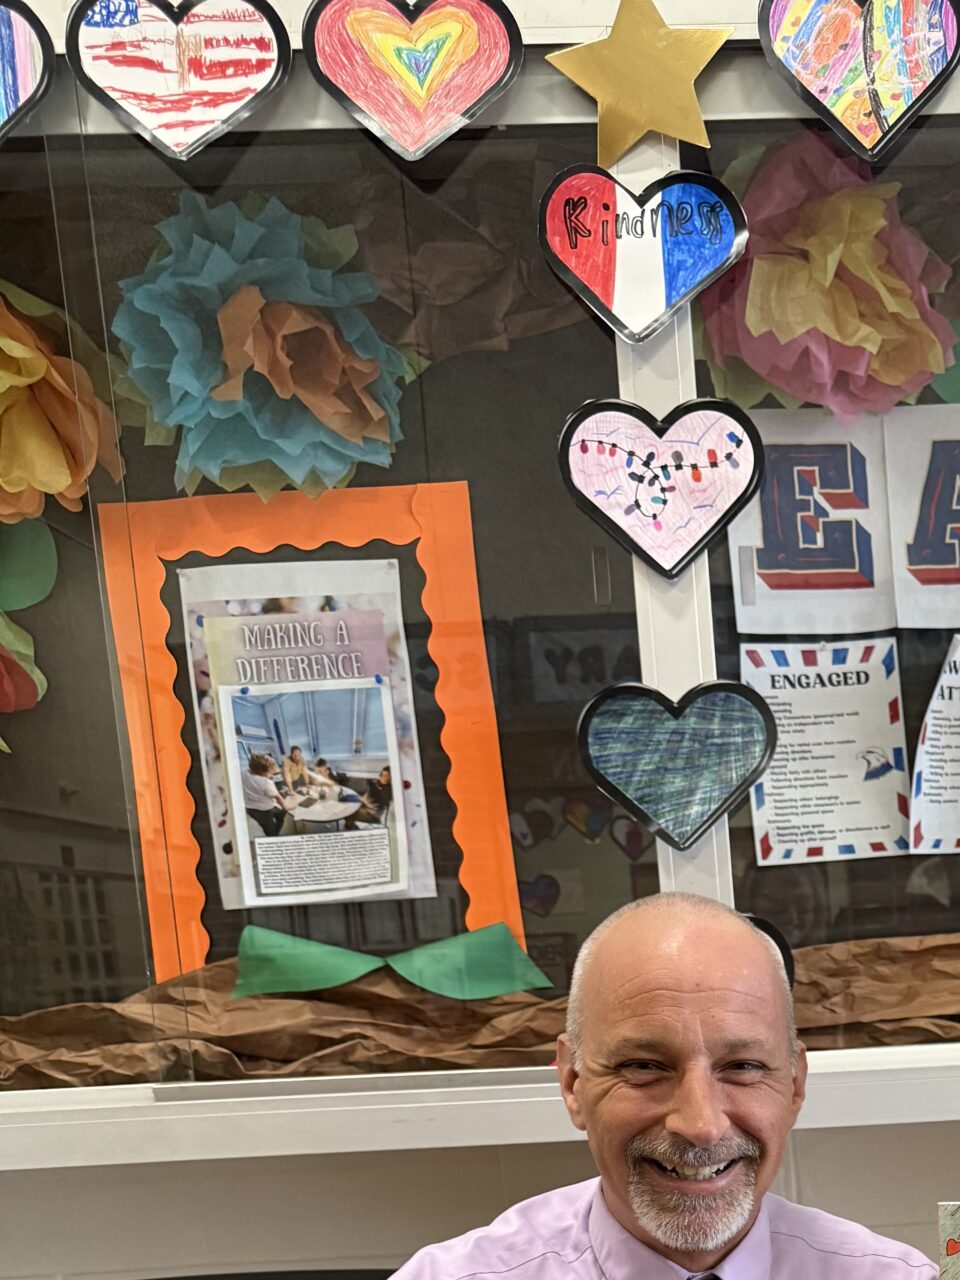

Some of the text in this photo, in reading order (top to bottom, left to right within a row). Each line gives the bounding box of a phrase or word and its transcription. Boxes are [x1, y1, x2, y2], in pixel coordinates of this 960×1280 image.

[242, 620, 350, 650] MAKING A
[236, 652, 364, 684] DIFFERENCE
[770, 671, 870, 690] ENGAGED
